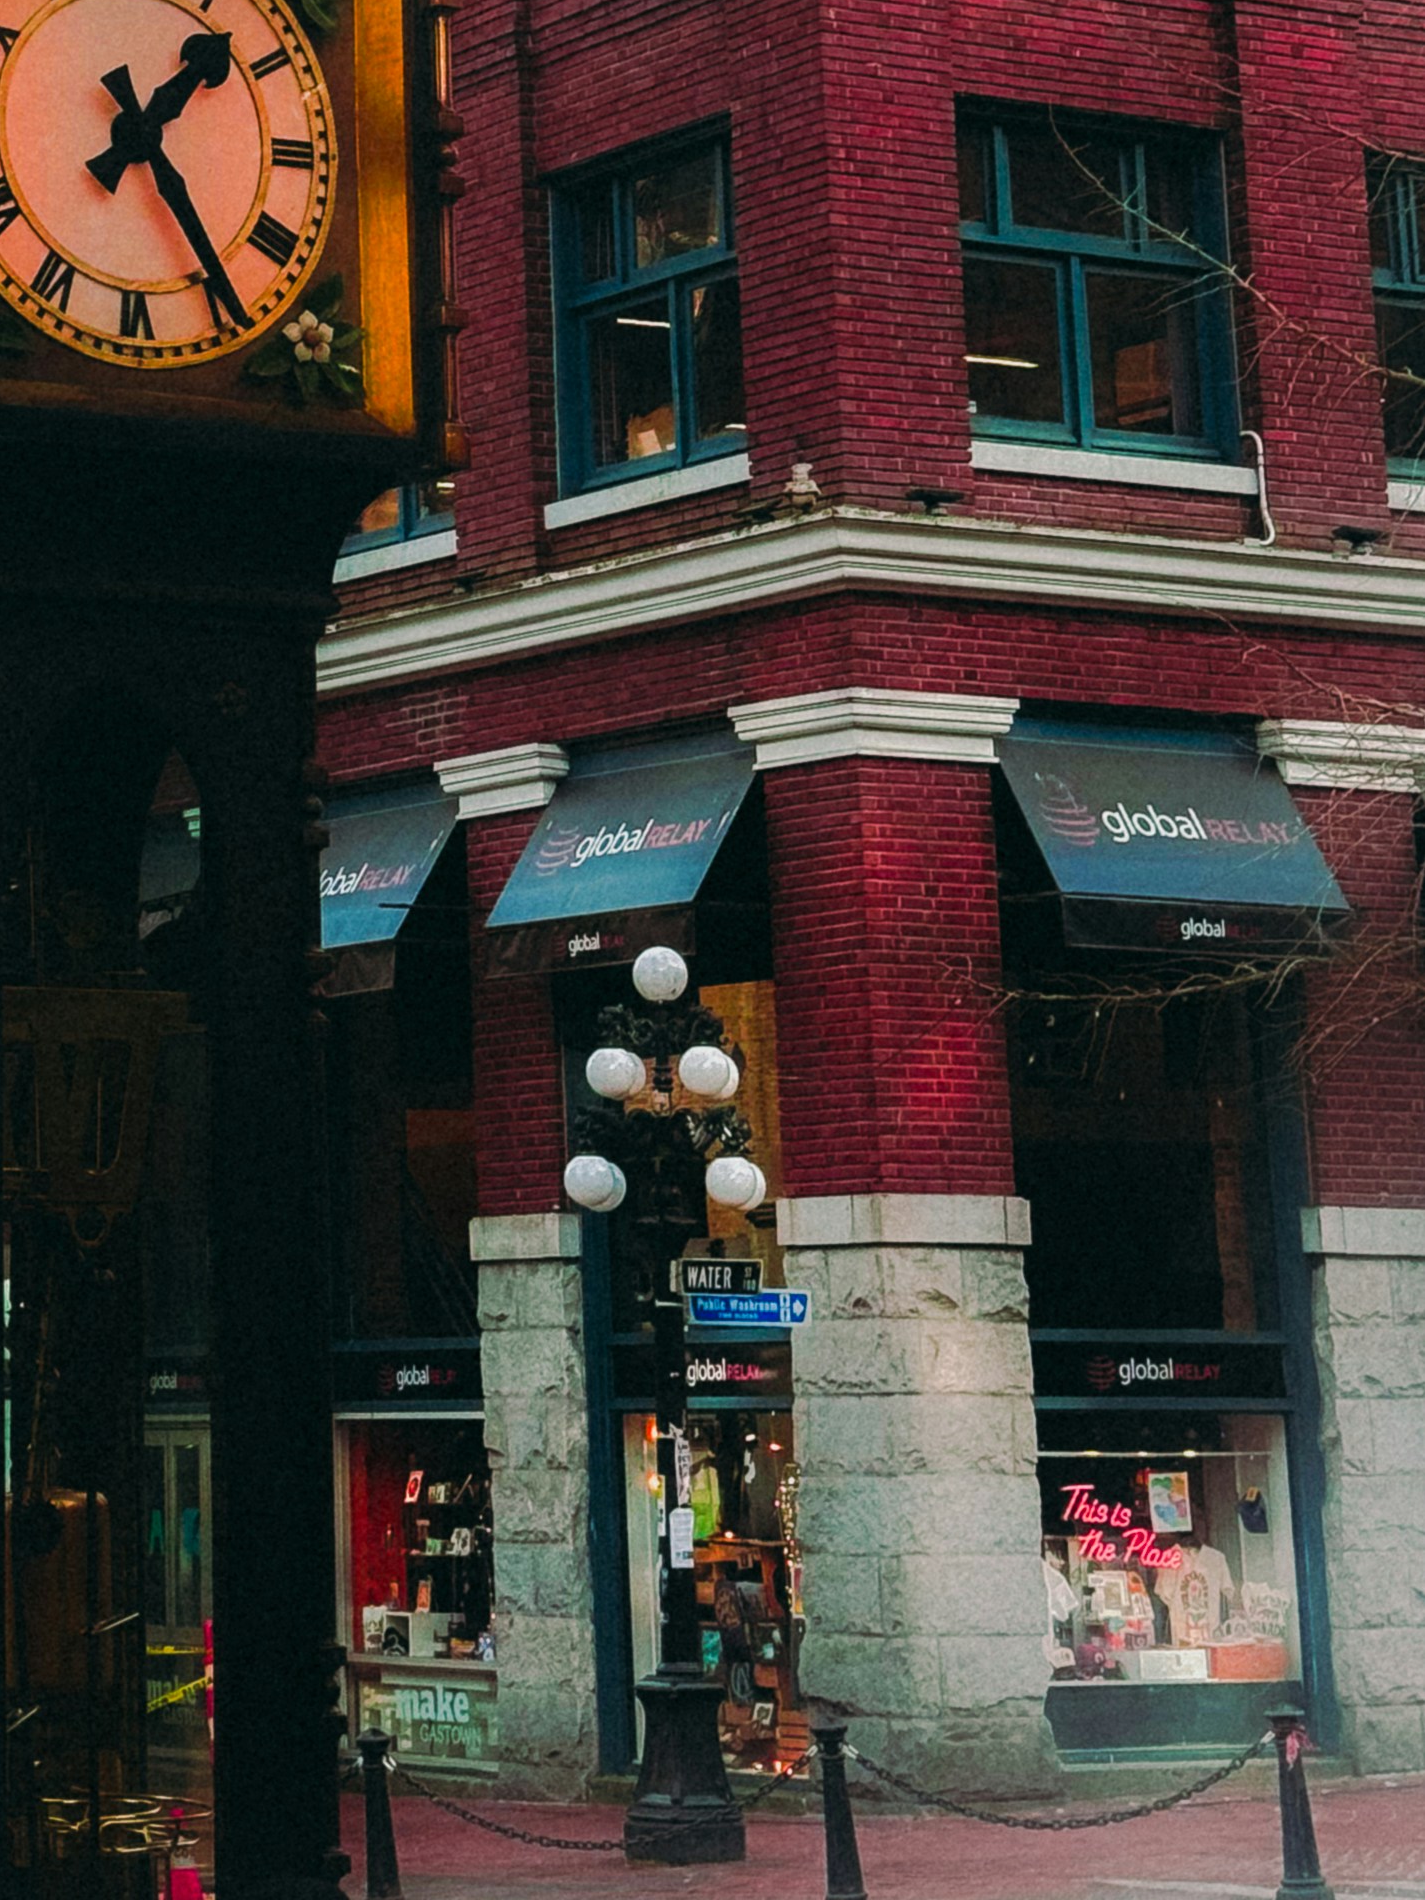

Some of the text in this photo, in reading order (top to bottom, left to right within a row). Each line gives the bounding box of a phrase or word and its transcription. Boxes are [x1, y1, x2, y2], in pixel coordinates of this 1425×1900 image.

[249, 47, 290, 81] II
[271, 137, 313, 170] III
[30, 249, 75, 314] VII
[120, 290, 156, 340] VI
[687, 1265, 732, 1290] WATER
[697, 1298, 778, 1312] Public Washroom
[1060, 1484, 1132, 1527] This is
[1078, 1528, 1183, 1568] the Place
[394, 1682, 471, 1724] make
[419, 1723, 482, 1750] GASTOWN
